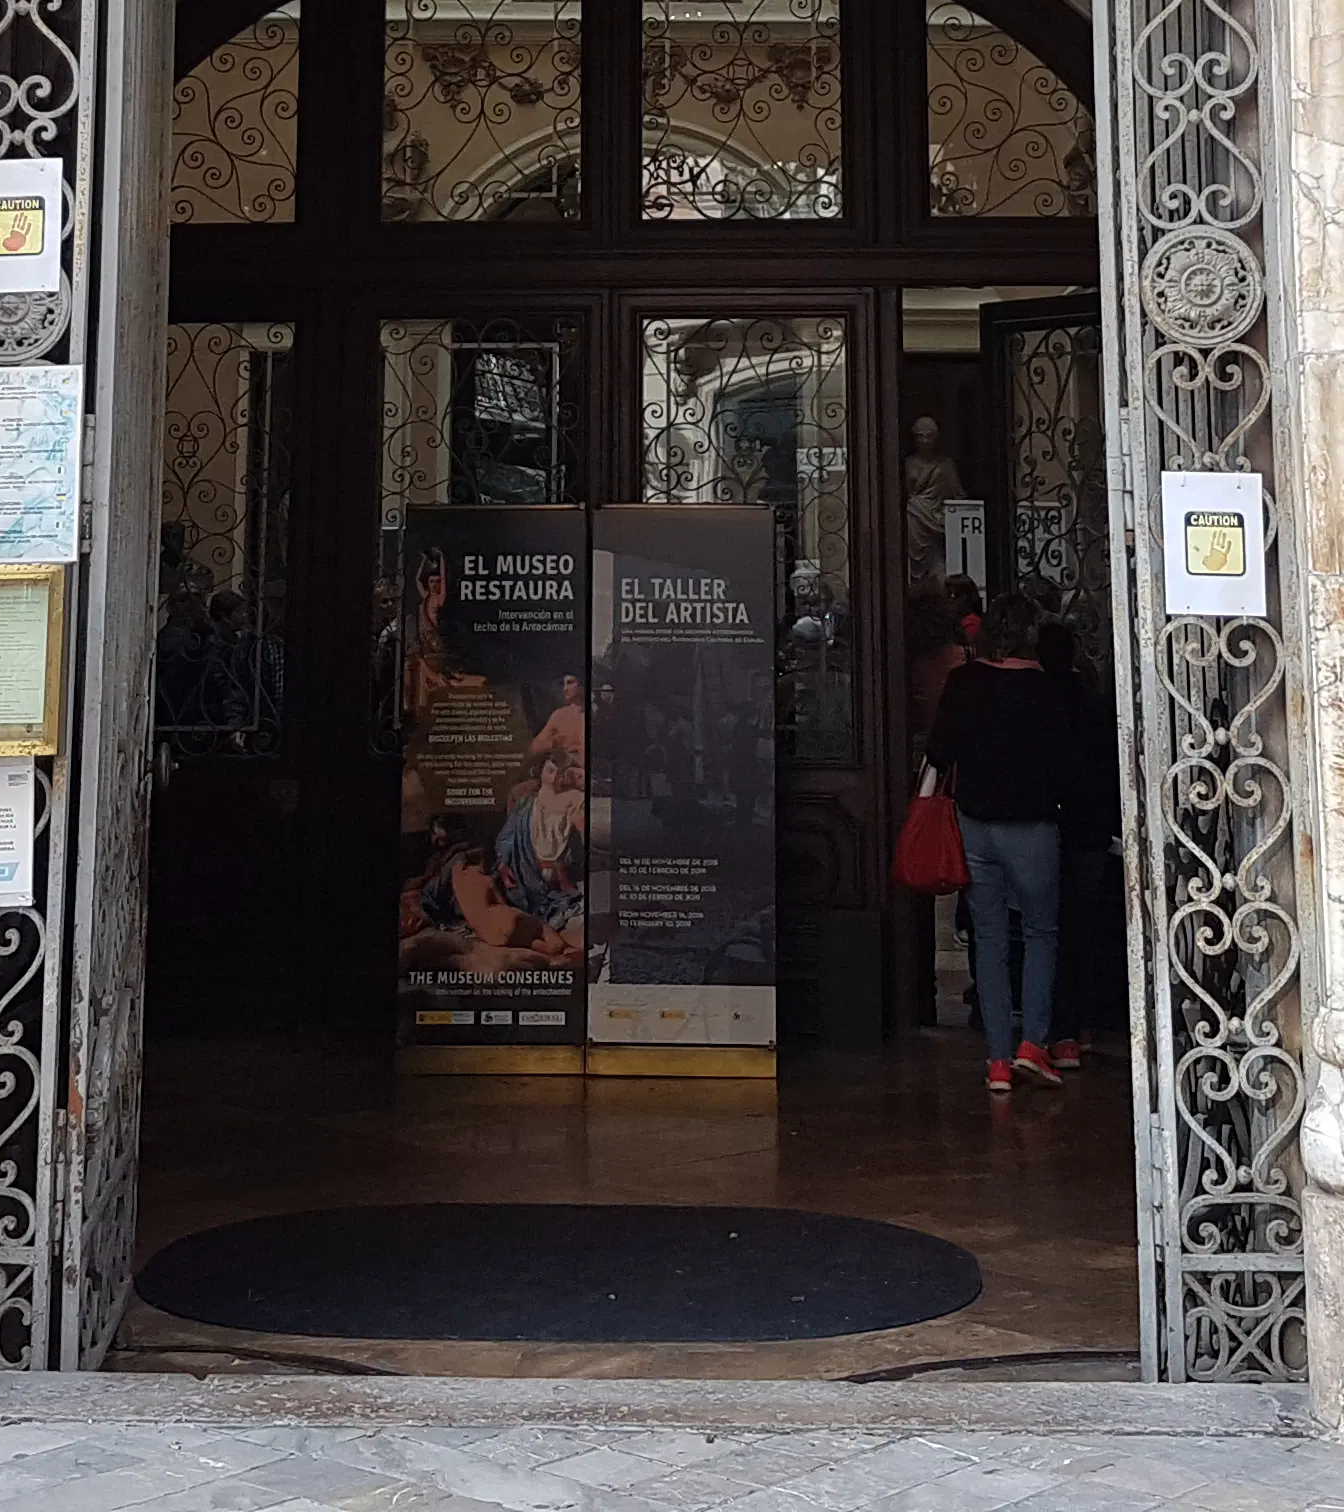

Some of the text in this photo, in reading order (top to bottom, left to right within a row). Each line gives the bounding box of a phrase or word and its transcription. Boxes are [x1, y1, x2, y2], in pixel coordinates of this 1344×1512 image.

[1190, 515, 1238, 526] CAUTION
[464, 554, 574, 575] EL MUSEO
[460, 580, 574, 600] RESTAURA
[621, 578, 726, 599] EL TALLER
[553, 608, 564, 620] en
[566, 608, 574, 620] el
[621, 602, 749, 624] DEL ARTISTA
[474, 621, 497, 632] techo
[499, 621, 511, 632] de
[512, 621, 521, 632] la
[409, 971, 574, 984] THE MUSEUM CONSERVES
